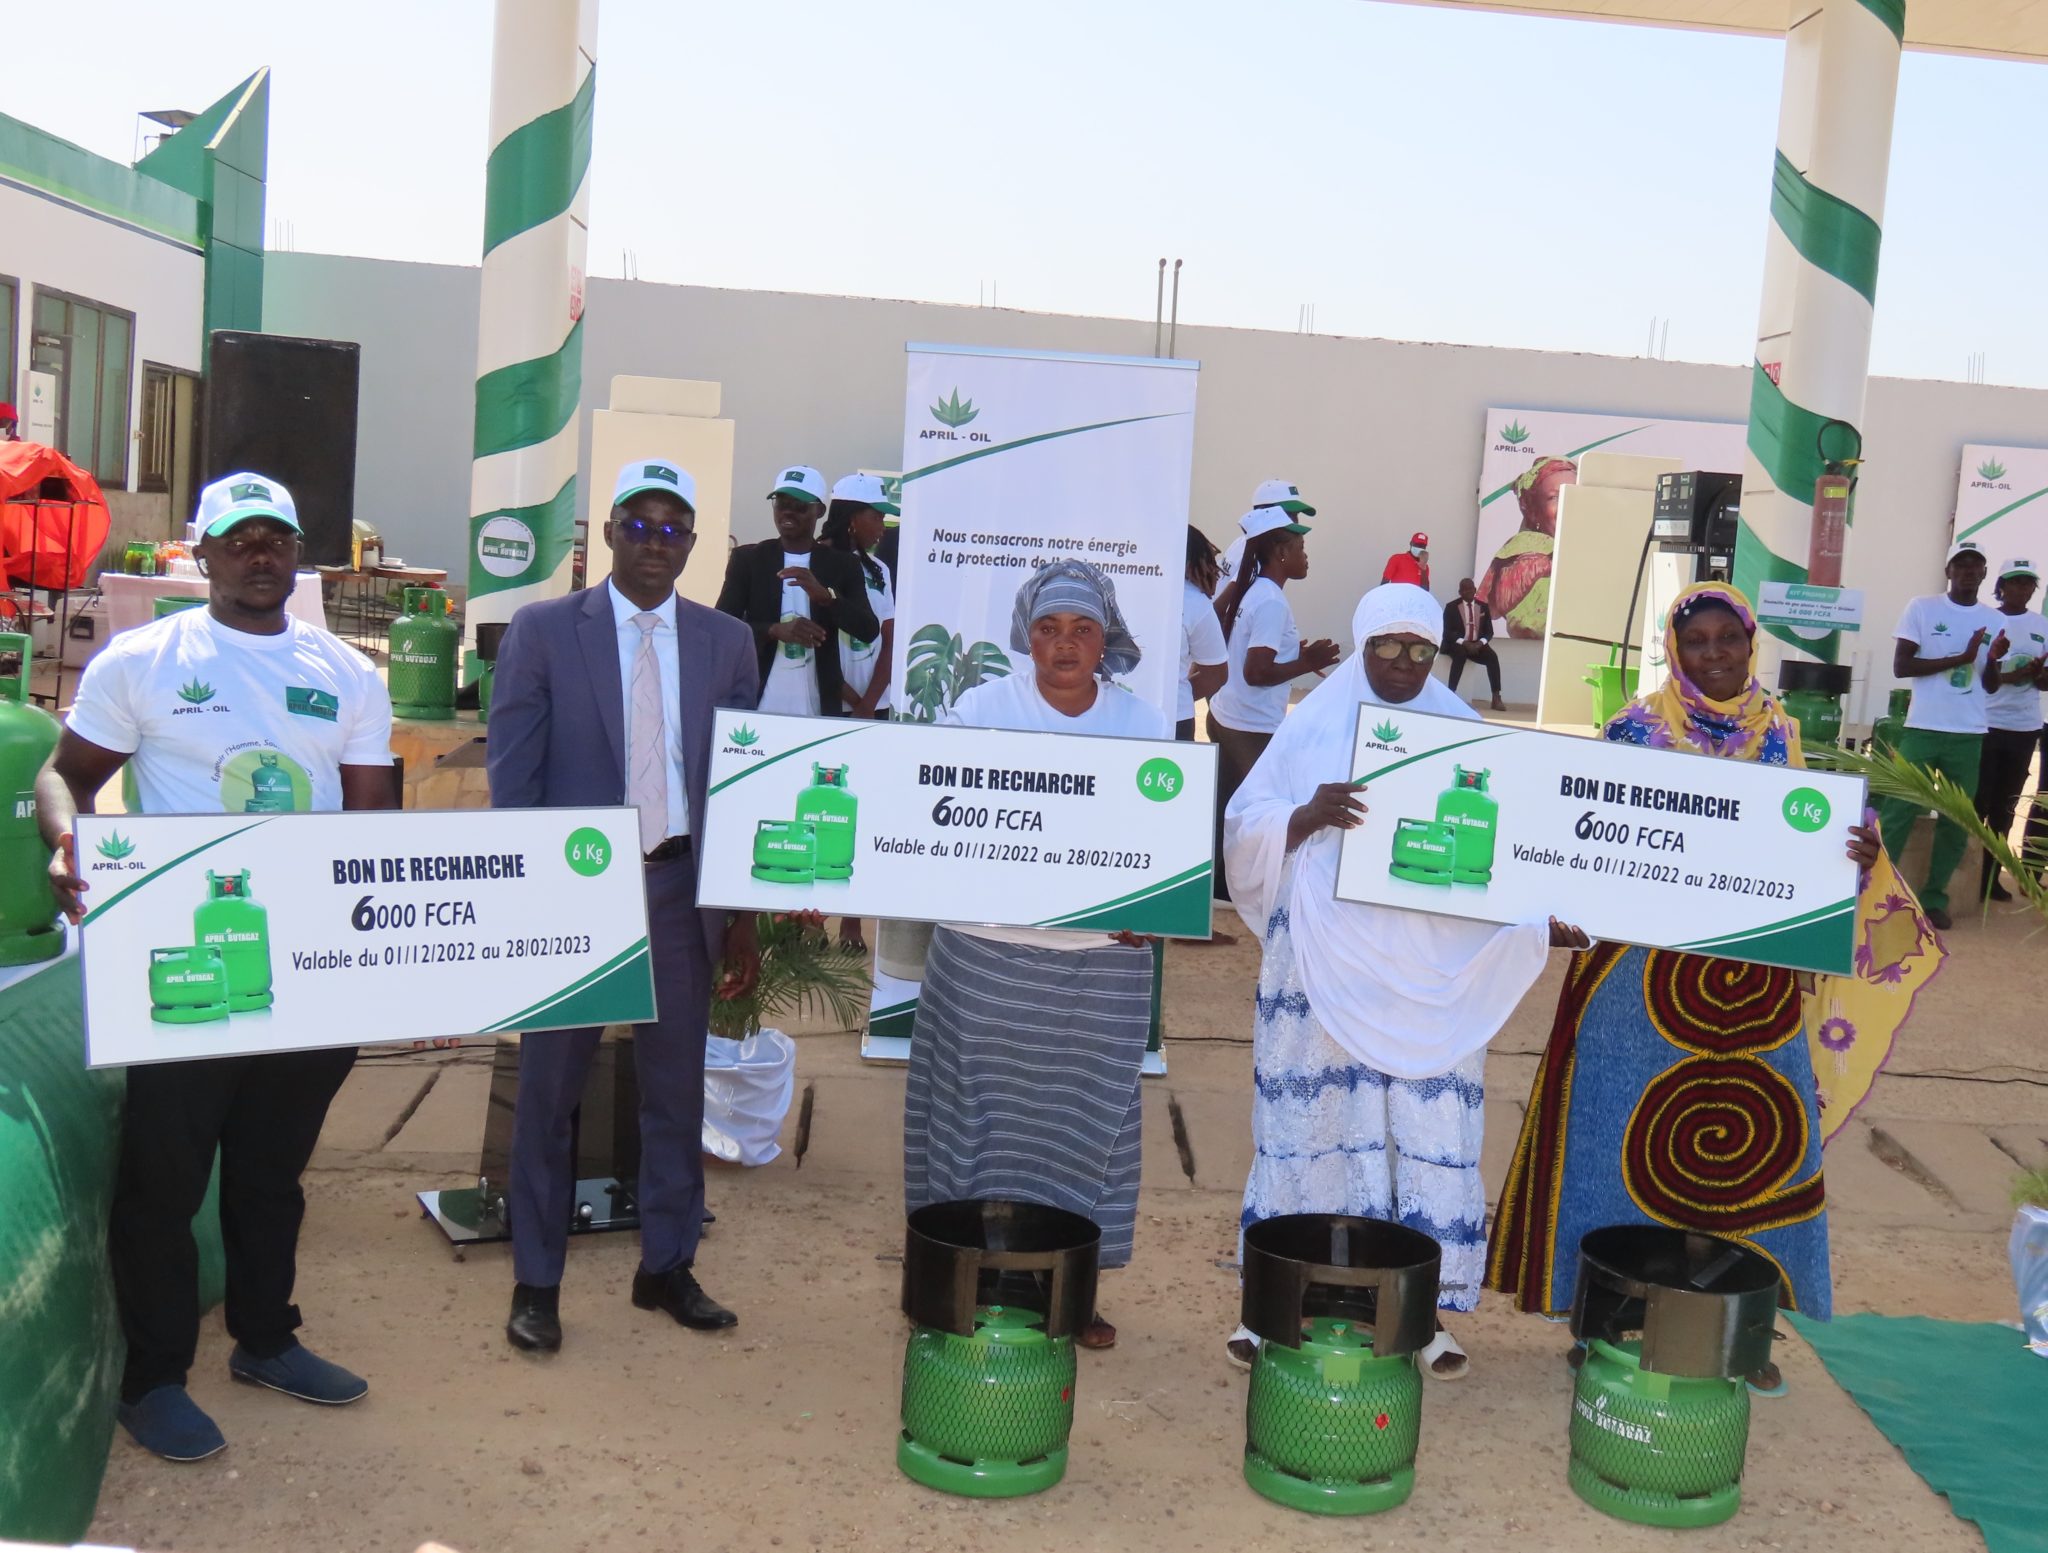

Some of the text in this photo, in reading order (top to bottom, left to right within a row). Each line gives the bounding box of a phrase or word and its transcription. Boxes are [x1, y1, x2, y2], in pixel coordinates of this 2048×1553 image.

[919, 429, 958, 441] APRIL
[969, 432, 992, 443] OIL
[933, 528, 1138, 557] Nous consacrons notre énergie
[928, 548, 937, 562] à
[940, 549, 953, 563] la
[956, 551, 1027, 568] protection
[172, 705, 204, 715] APRIL
[212, 704, 231, 713] OIL
[224, 740, 262, 756] l'Homme,
[722, 747, 766, 757] APRIL-OIL
[919, 764, 1096, 796] BON DE RECHARCHE
[1143, 772, 1175, 792] 6 Kg
[1560, 775, 1741, 821] BON DE RECHARCHE
[932, 796, 1043, 832] 6000 FCFA
[1789, 802, 1823, 824] 6 Kg
[1574, 810, 1685, 853] 6000 FCFA
[92, 861, 147, 871] APRIL-OIL
[572, 843, 604, 865] 6 Kg
[873, 836, 1151, 869] Valable du 01/12/2022 au 28/02/2023
[332, 854, 526, 885] BON DE RECHARCHE
[1512, 843, 1796, 901] Valable du 01/12/2022 au 28/02/2023
[351, 895, 477, 932] 6000 FCFA
[205, 934, 226, 944] APRIL
[292, 935, 592, 971] Valable du 01/12/2022 au 28/02/2023
[1595, 1411, 1652, 1444] BUTAGAZ
